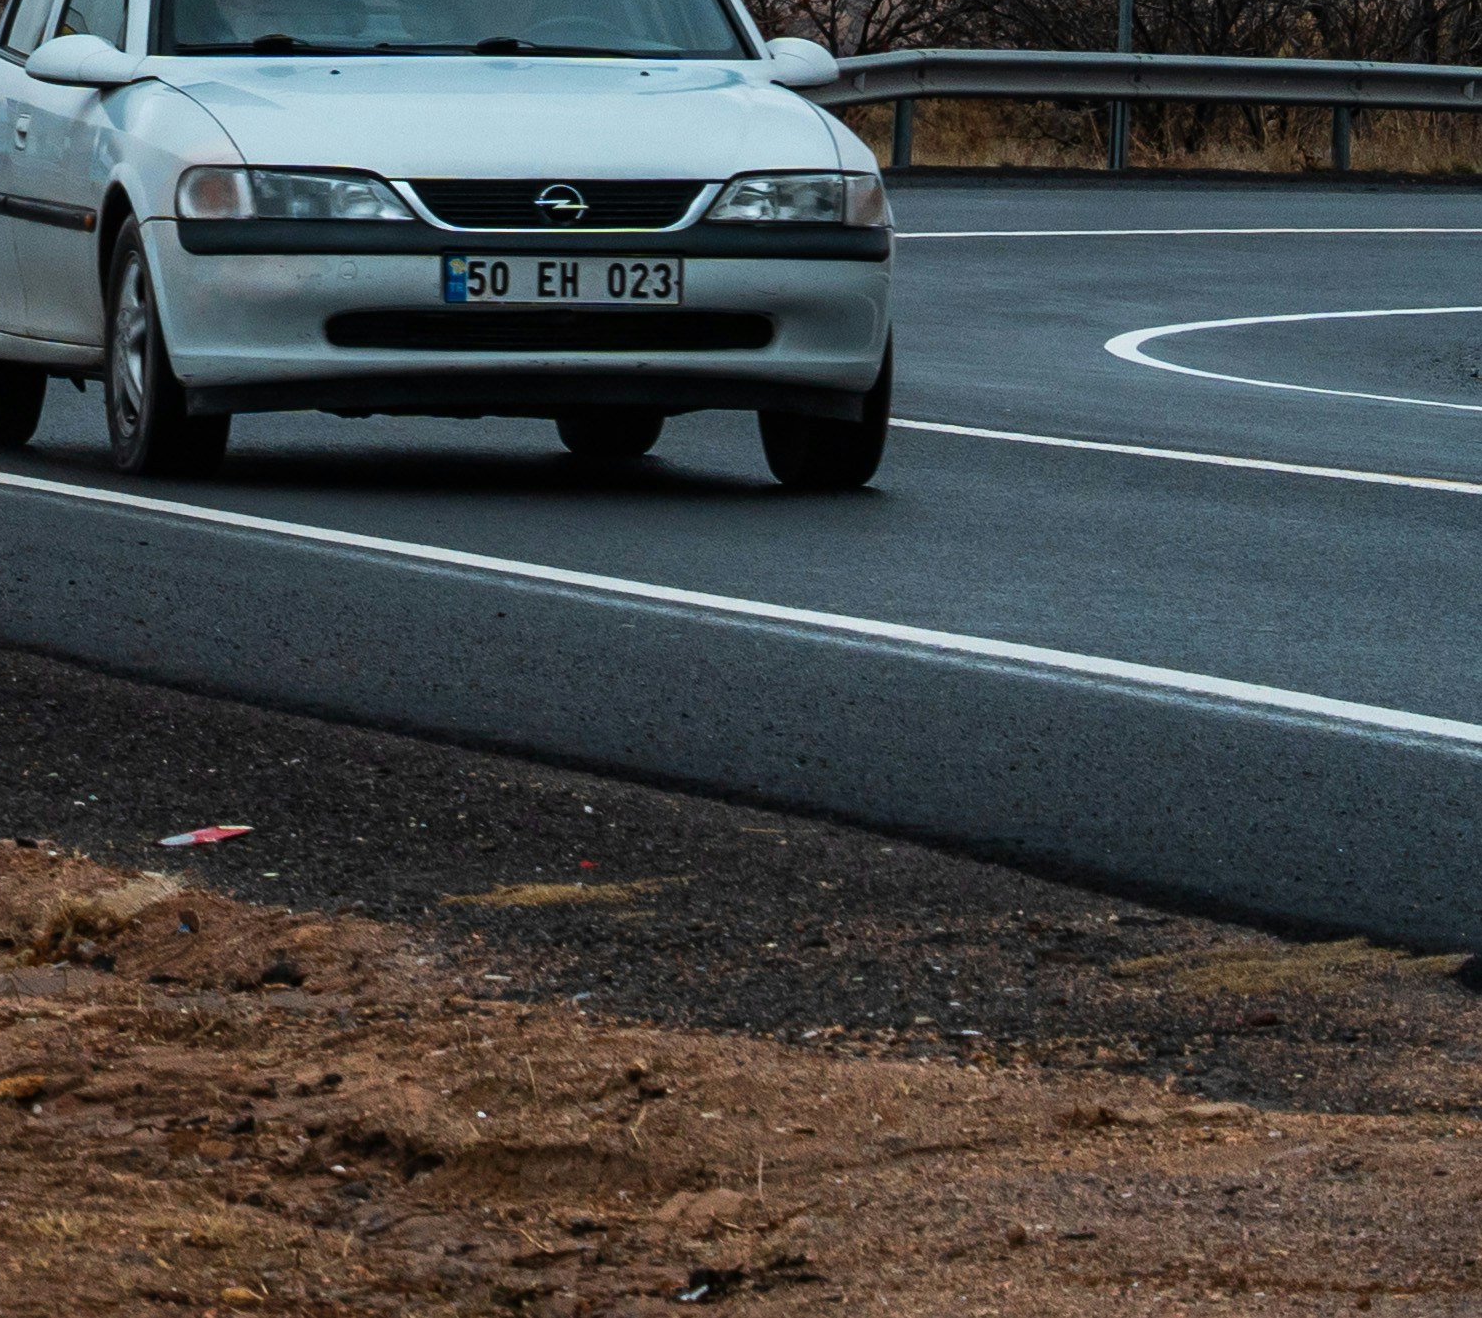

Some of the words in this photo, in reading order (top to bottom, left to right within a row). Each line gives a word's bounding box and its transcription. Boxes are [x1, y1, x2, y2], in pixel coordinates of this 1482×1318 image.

[466, 261, 509, 297] 50
[537, 261, 579, 298] EH
[607, 262, 672, 298] 023
